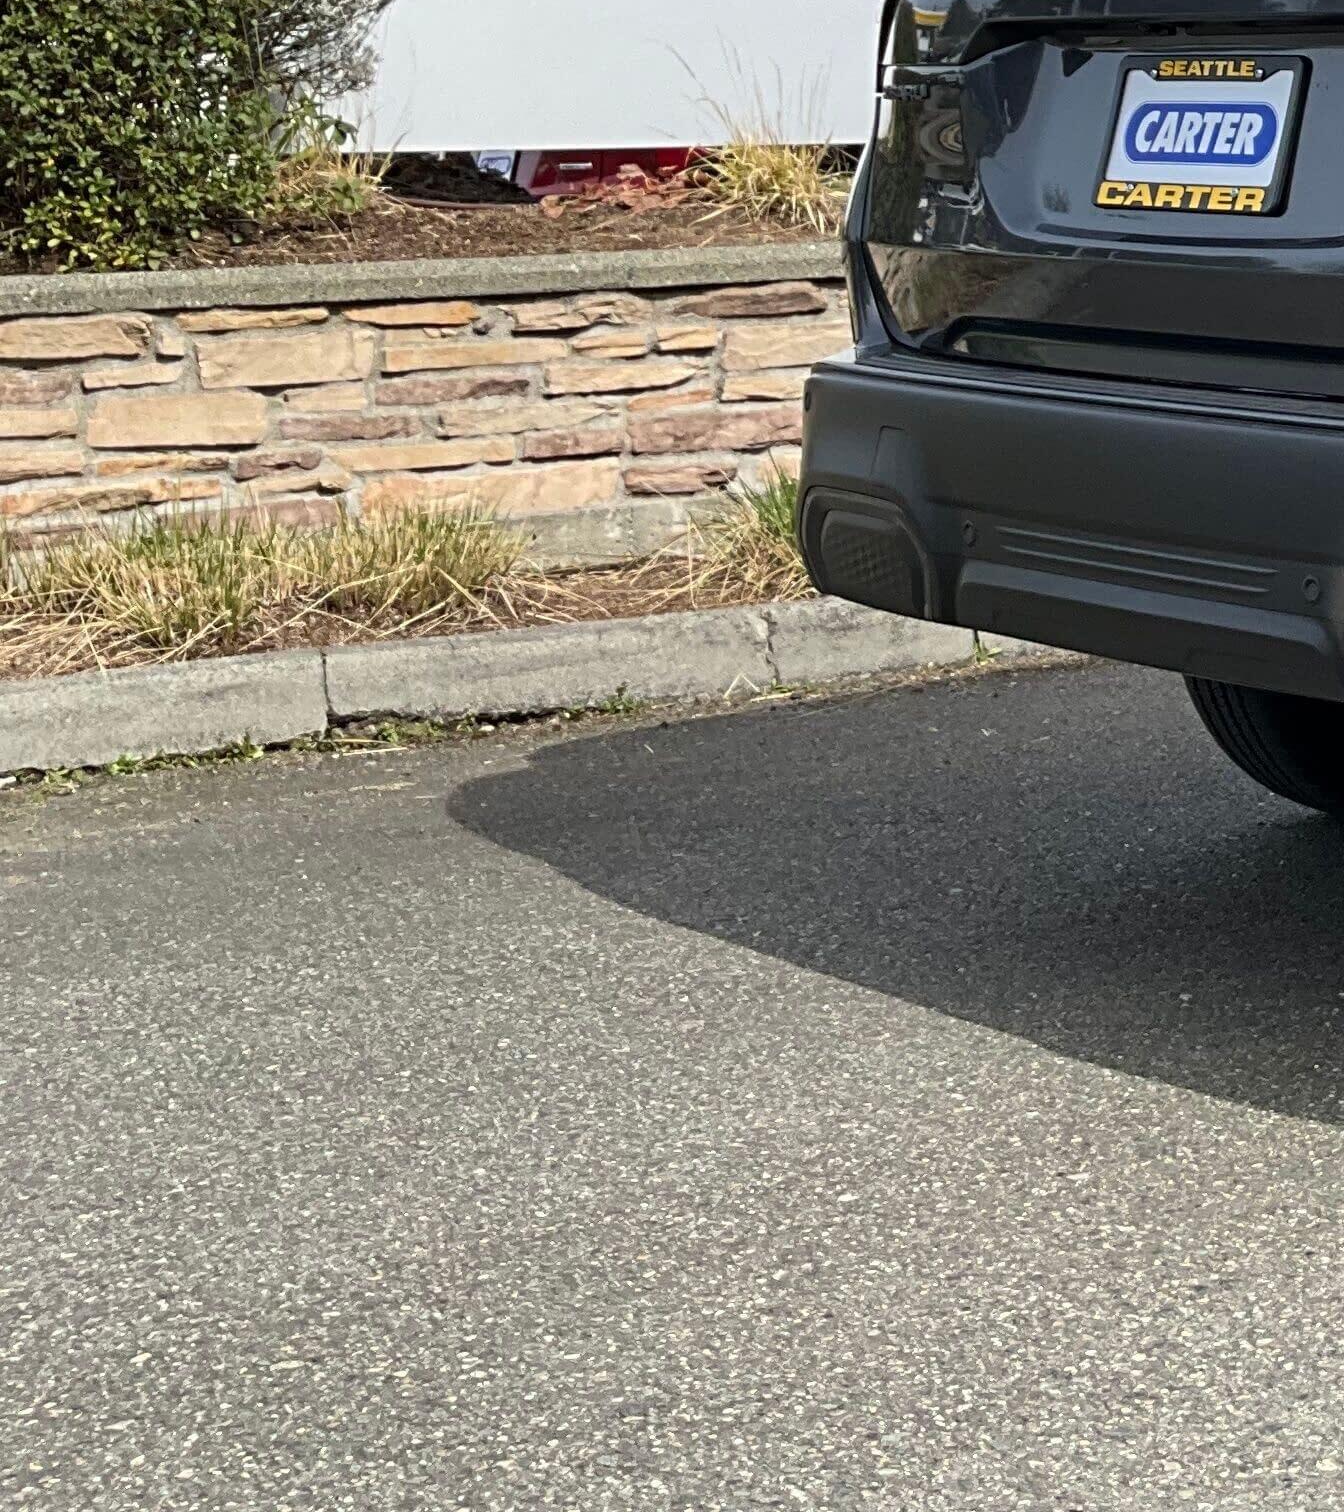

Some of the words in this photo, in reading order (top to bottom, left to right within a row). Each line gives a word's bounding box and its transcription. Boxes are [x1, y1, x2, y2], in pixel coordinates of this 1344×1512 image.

[1158, 60, 1256, 78] SEATTLE
[1134, 109, 1264, 156] CARTER
[1096, 181, 1266, 213] CARTER
